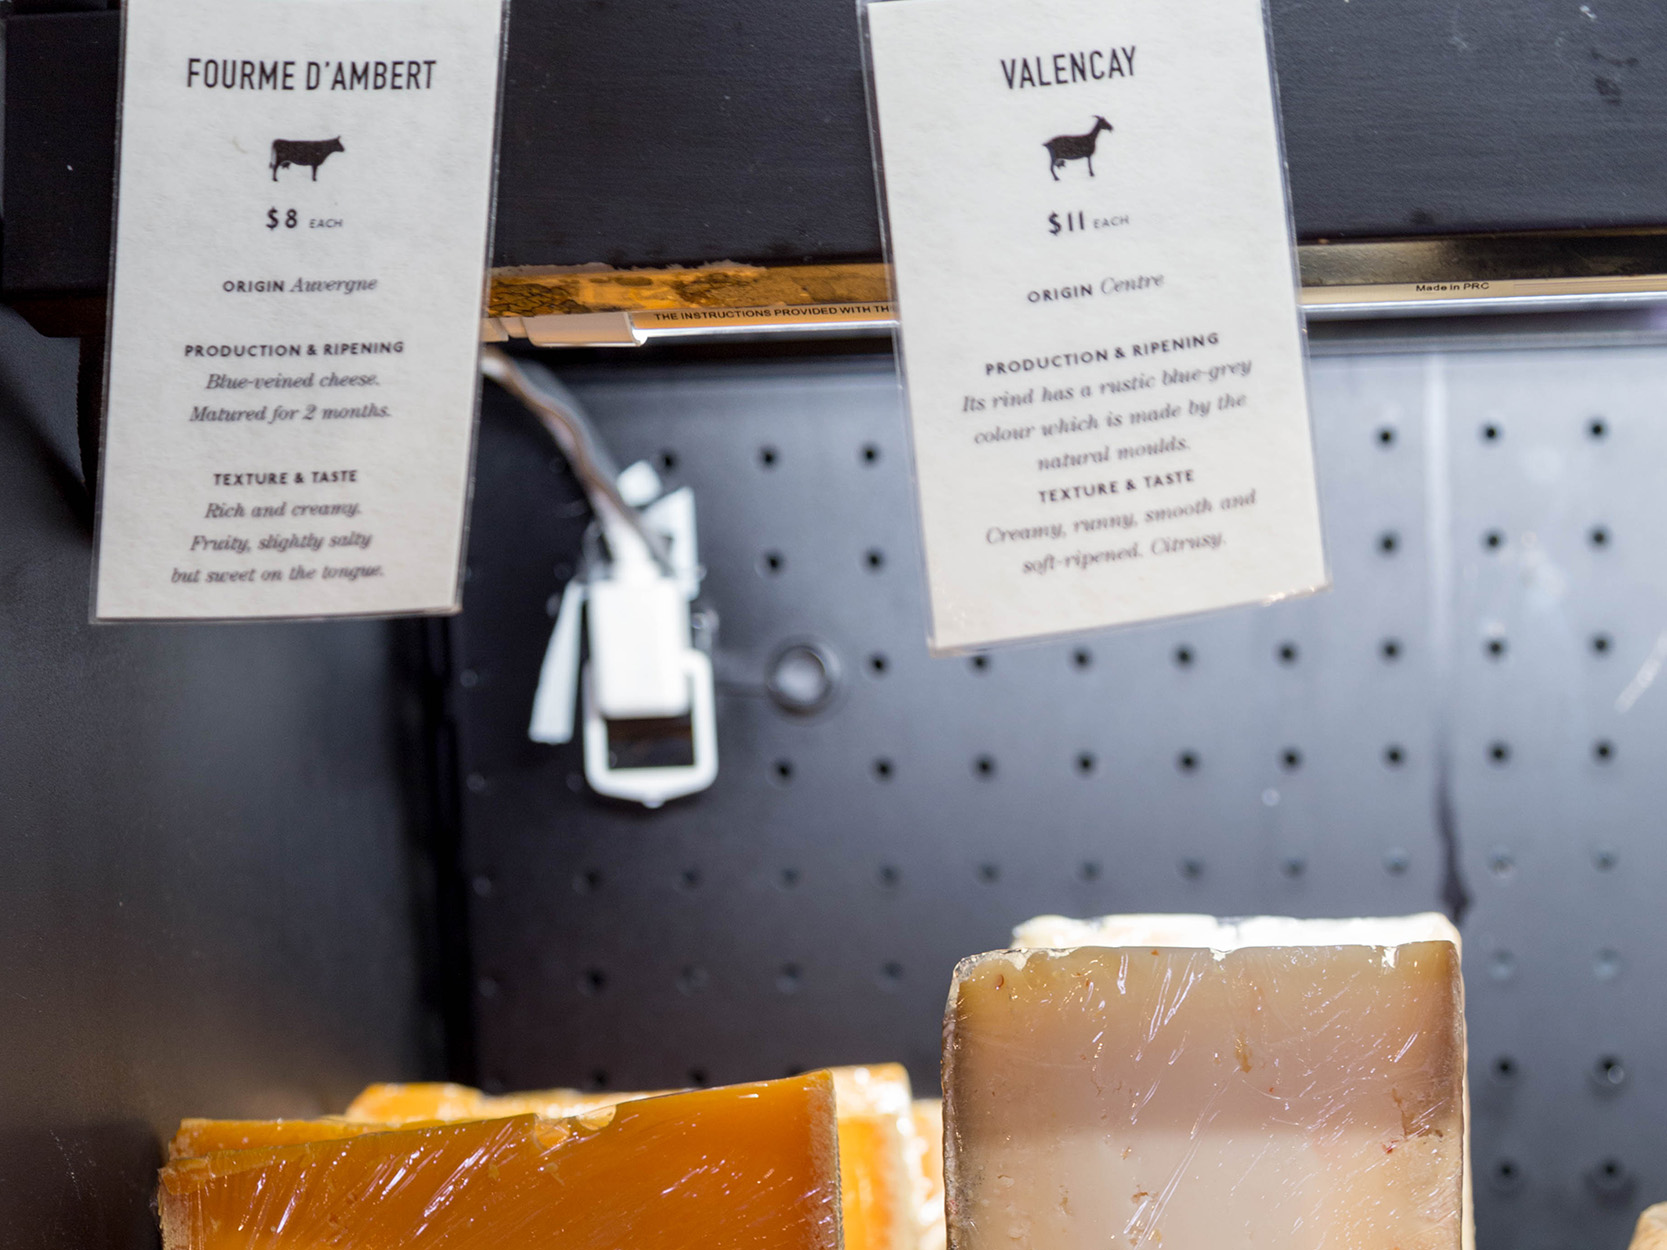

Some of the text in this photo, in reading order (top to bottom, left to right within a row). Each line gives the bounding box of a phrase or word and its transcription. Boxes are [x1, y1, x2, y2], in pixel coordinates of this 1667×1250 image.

[187, 58, 295, 90] FOURME
[1000, 46, 1135, 89] VALENCAY
[309, 219, 343, 229] EACH
[1048, 211, 1129, 236] $11 EACH
[222, 277, 378, 295] ORIGIN Auvergne
[1027, 275, 1164, 303] ORIGIN Centre
[1463, 282, 1489, 290] PRC
[654, 305, 892, 320] THE INSTRUCTIONS PROVIDED WITH TH
[184, 341, 404, 357] PRODUCTION & RIPENING
[985, 332, 1219, 376] PRODUCTION & RIPENING
[205, 372, 379, 389] Blue-veined cheese.
[962, 360, 1252, 413] Its rind has a rustic blue-grey
[189, 403, 391, 424] Matured for 2 months.
[974, 393, 1247, 444] colour which is made by the
[1038, 436, 1190, 471] natural moulds.
[214, 470, 357, 486] TEXTURE & TASTE
[1038, 469, 1194, 503] TEXTURE & TASTE
[204, 501, 361, 519] Rich and creamy.
[985, 488, 1256, 544] Creamy, runny, smooth and
[190, 531, 373, 554] Fruity, slightly salty
[171, 565, 383, 584] but sweet on the tongue.
